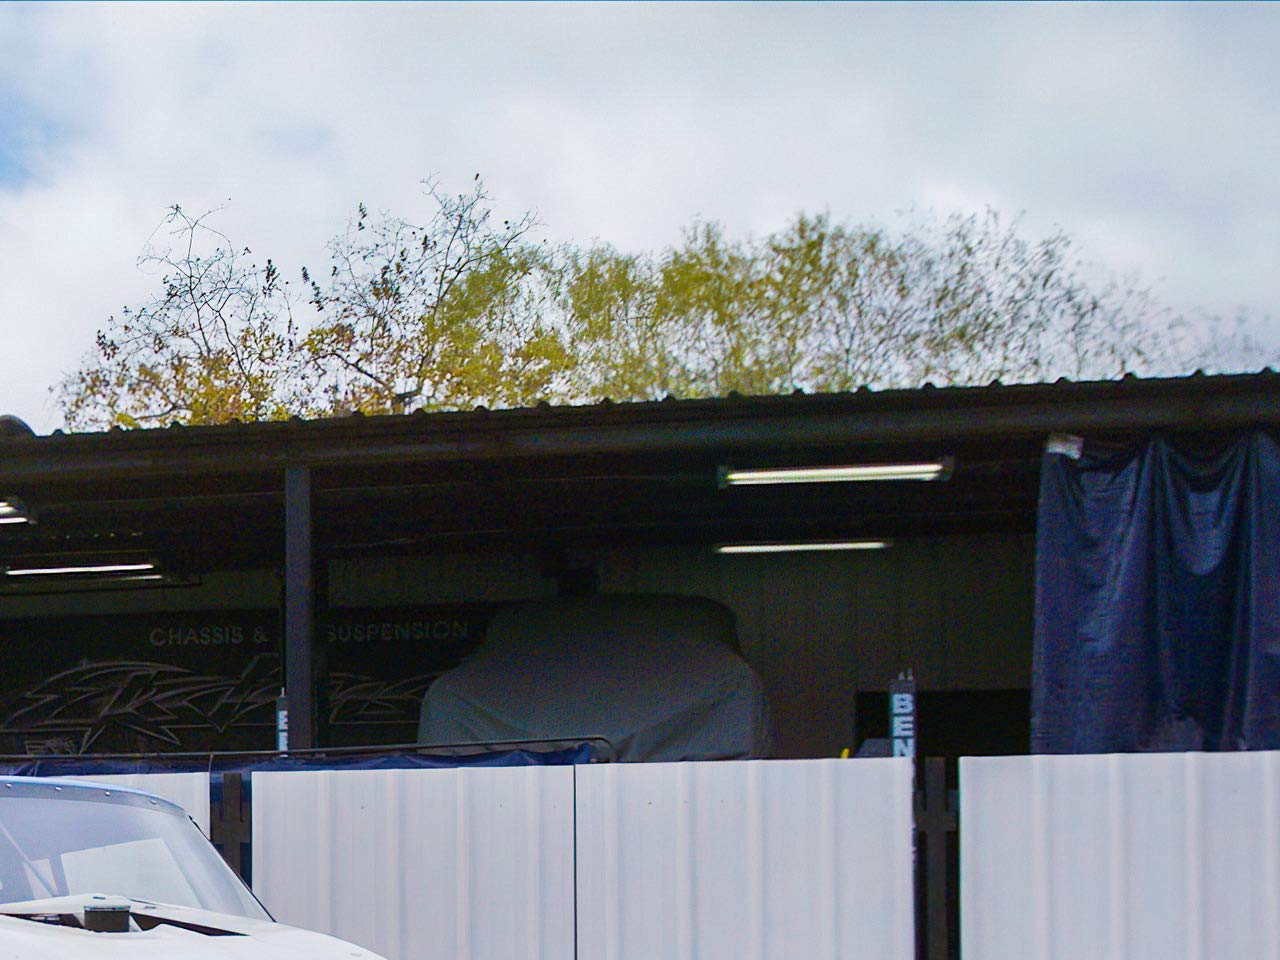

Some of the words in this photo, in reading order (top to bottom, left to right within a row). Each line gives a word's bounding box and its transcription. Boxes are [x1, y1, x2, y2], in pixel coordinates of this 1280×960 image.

[149, 626, 245, 647] CHASSIS
[252, 625, 270, 644] &
[327, 619, 470, 643] SUSPENSION
